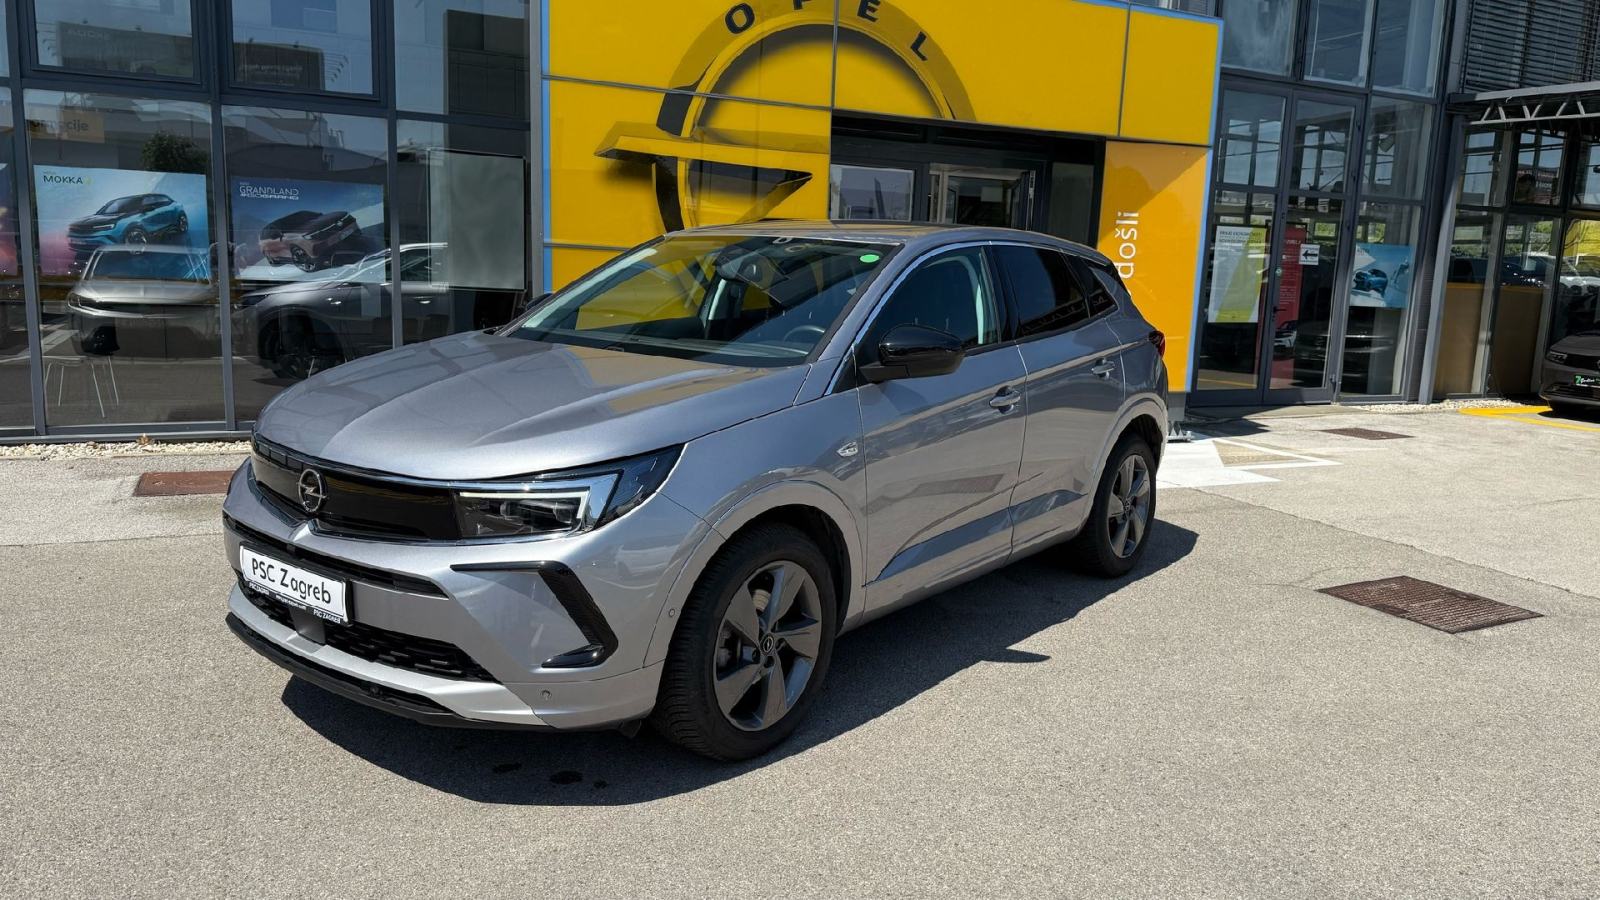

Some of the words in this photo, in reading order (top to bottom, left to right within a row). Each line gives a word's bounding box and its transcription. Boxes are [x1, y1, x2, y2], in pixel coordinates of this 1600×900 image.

[43, 175, 83, 185] MOKKA
[239, 185, 299, 196] GRANDLAND
[1112, 211, 1139, 279] došli
[251, 557, 275, 583] PSC
[280, 567, 332, 604] Zagreb
